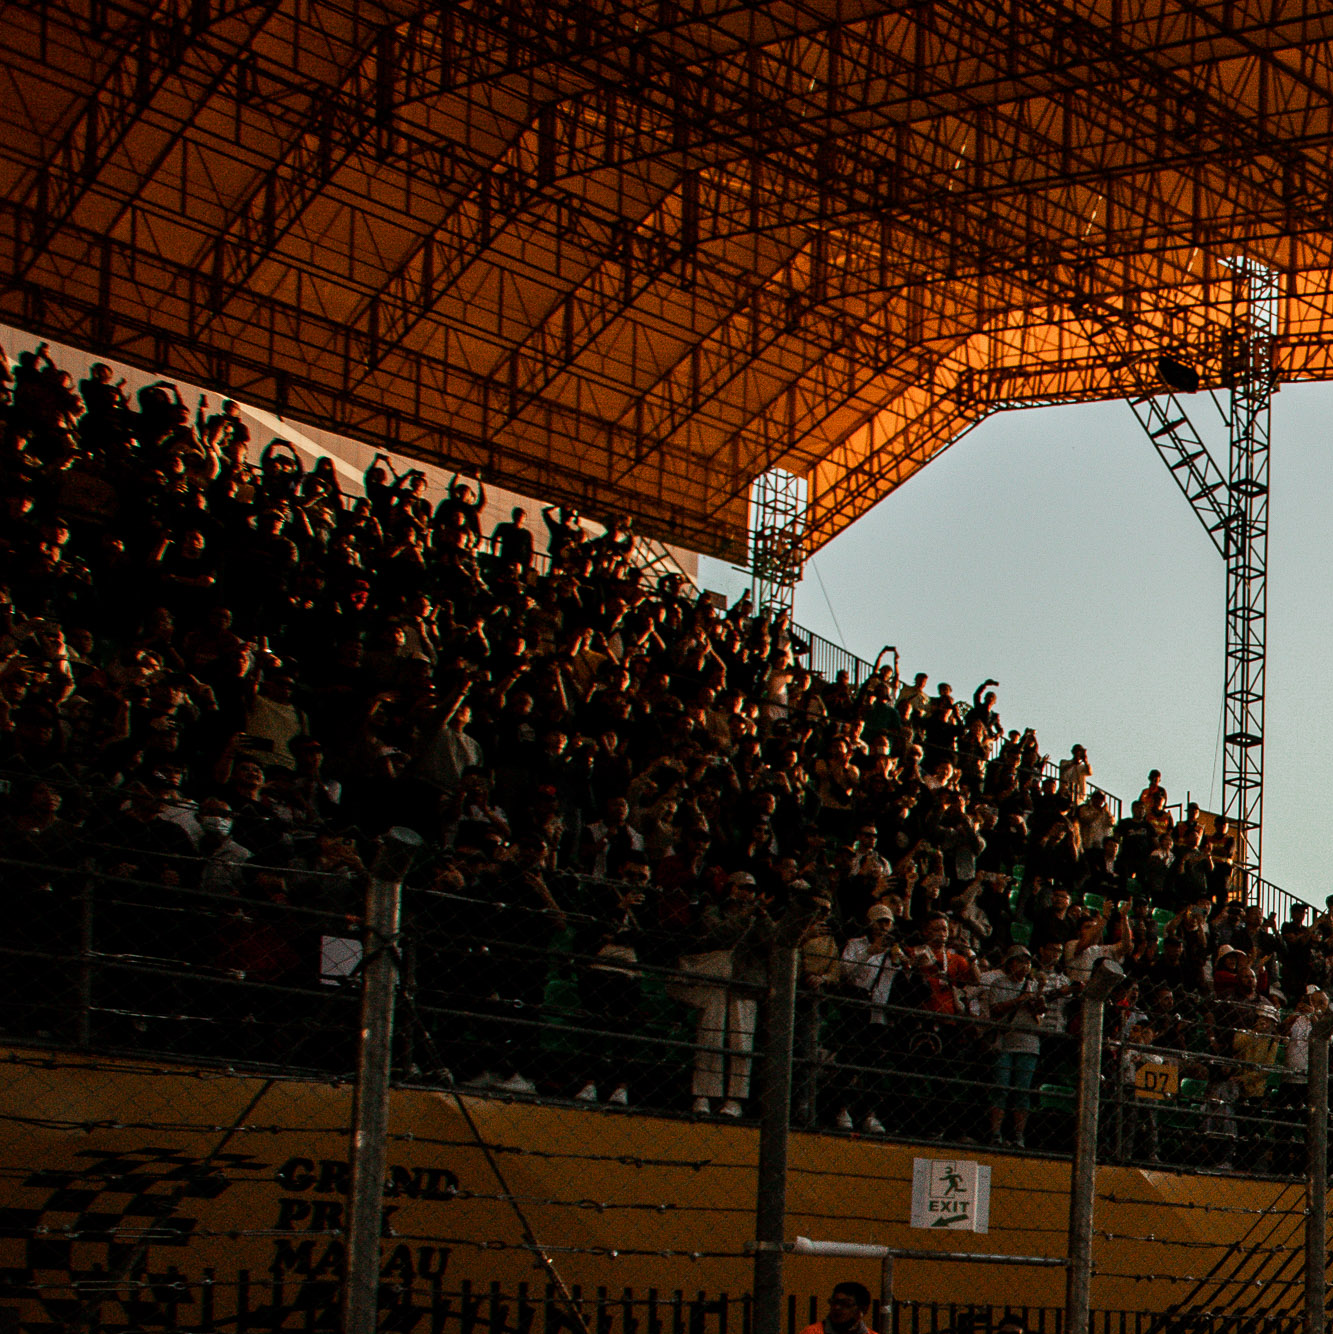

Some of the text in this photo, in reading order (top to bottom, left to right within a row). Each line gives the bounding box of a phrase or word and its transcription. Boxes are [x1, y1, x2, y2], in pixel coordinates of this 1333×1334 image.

[1144, 1070, 1170, 1092] D7
[278, 1157, 459, 1200] GRND
[928, 1199, 971, 1213] EXIT
[269, 1240, 452, 1278] MAAU
